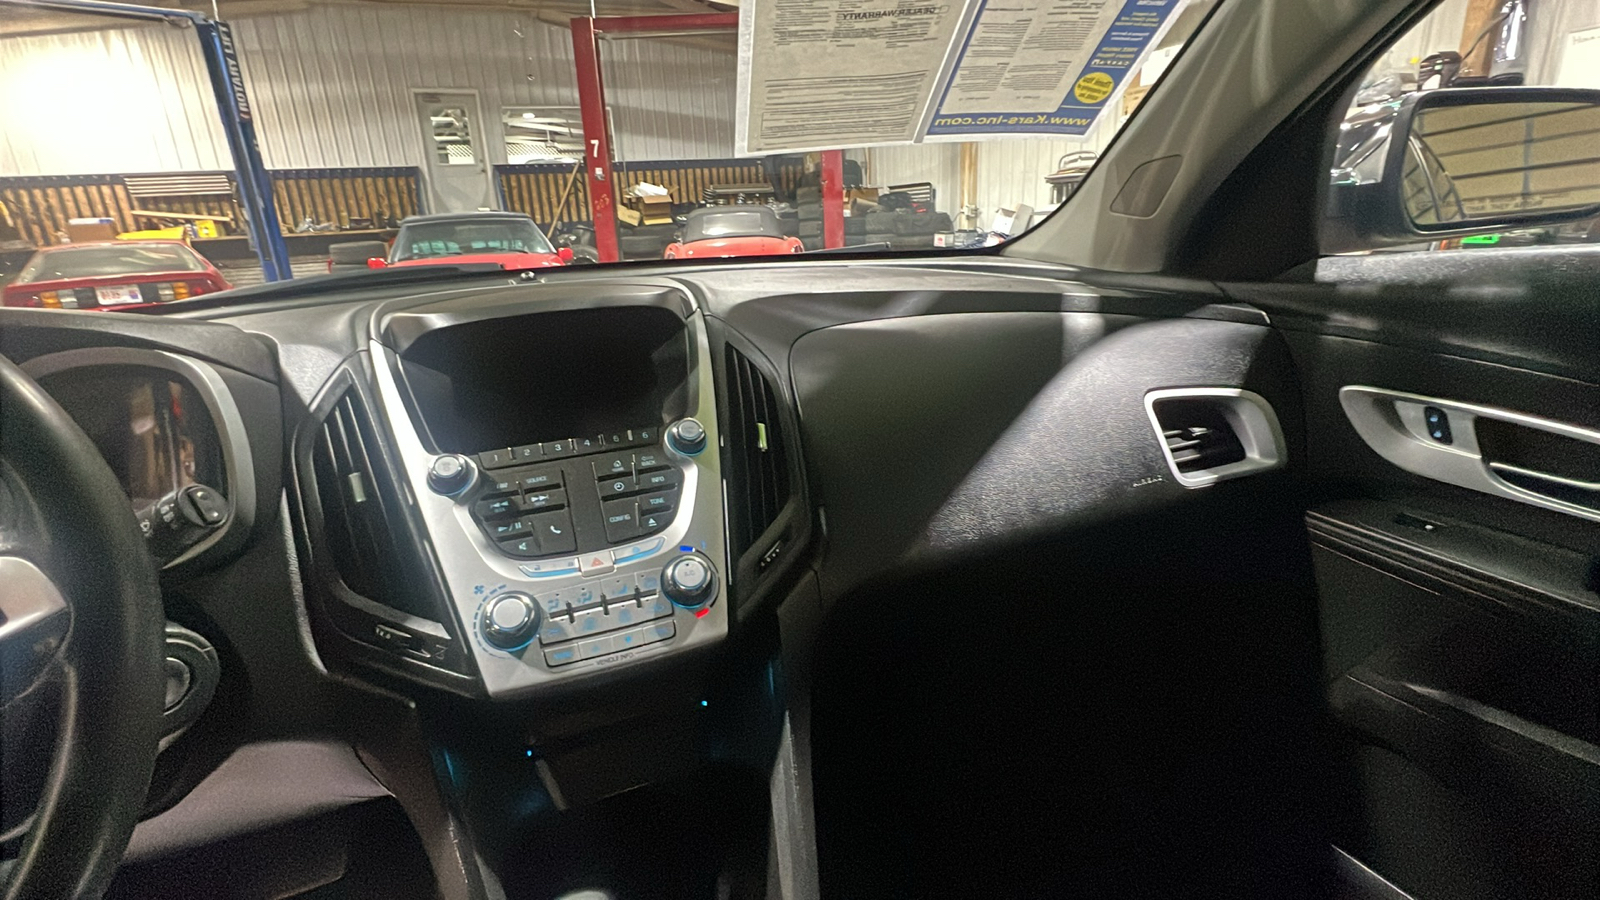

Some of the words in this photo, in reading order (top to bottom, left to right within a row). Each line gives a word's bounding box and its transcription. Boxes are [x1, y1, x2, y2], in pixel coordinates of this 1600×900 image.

[218, 25, 234, 55] LIFT
[226, 57, 250, 112] ROTARY
[590, 139, 600, 158] 7
